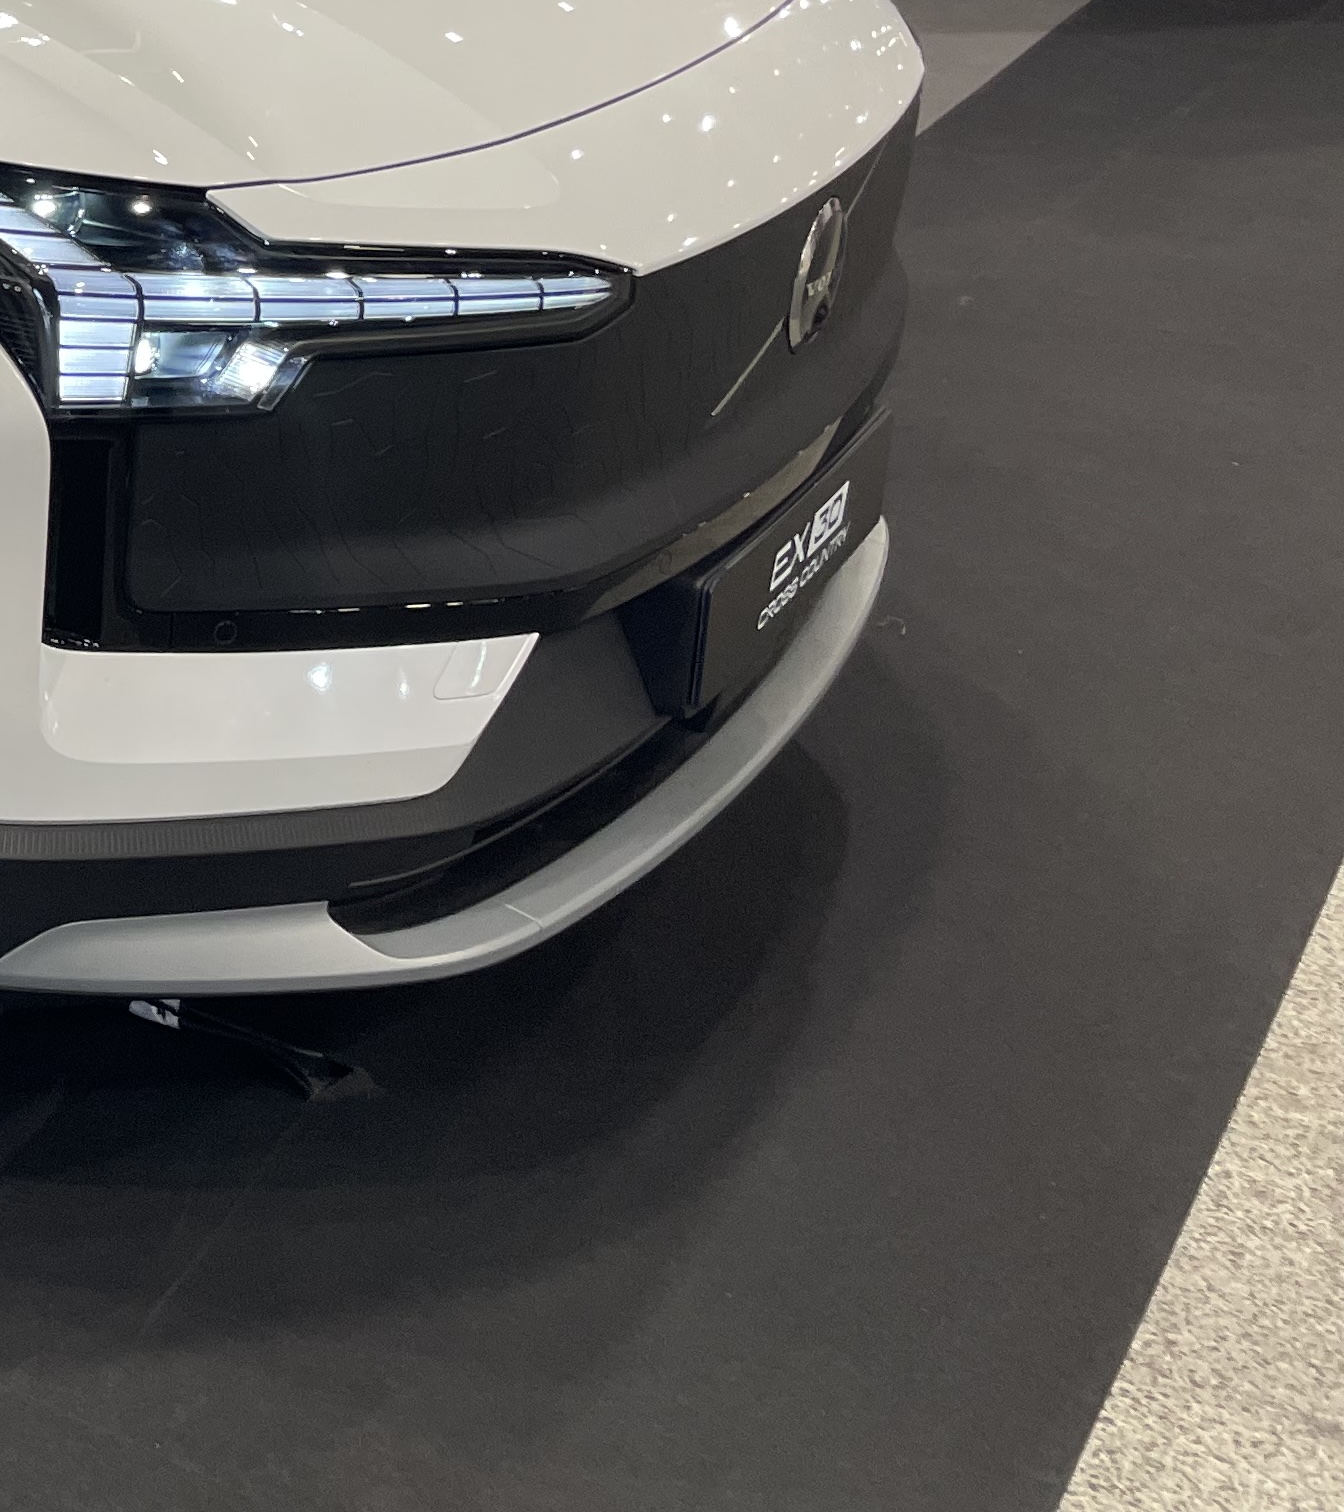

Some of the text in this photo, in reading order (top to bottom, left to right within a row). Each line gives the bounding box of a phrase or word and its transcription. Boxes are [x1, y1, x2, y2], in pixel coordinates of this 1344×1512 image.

[757, 520, 852, 631] CROSS COUNTRY
[769, 480, 851, 593] EX30
